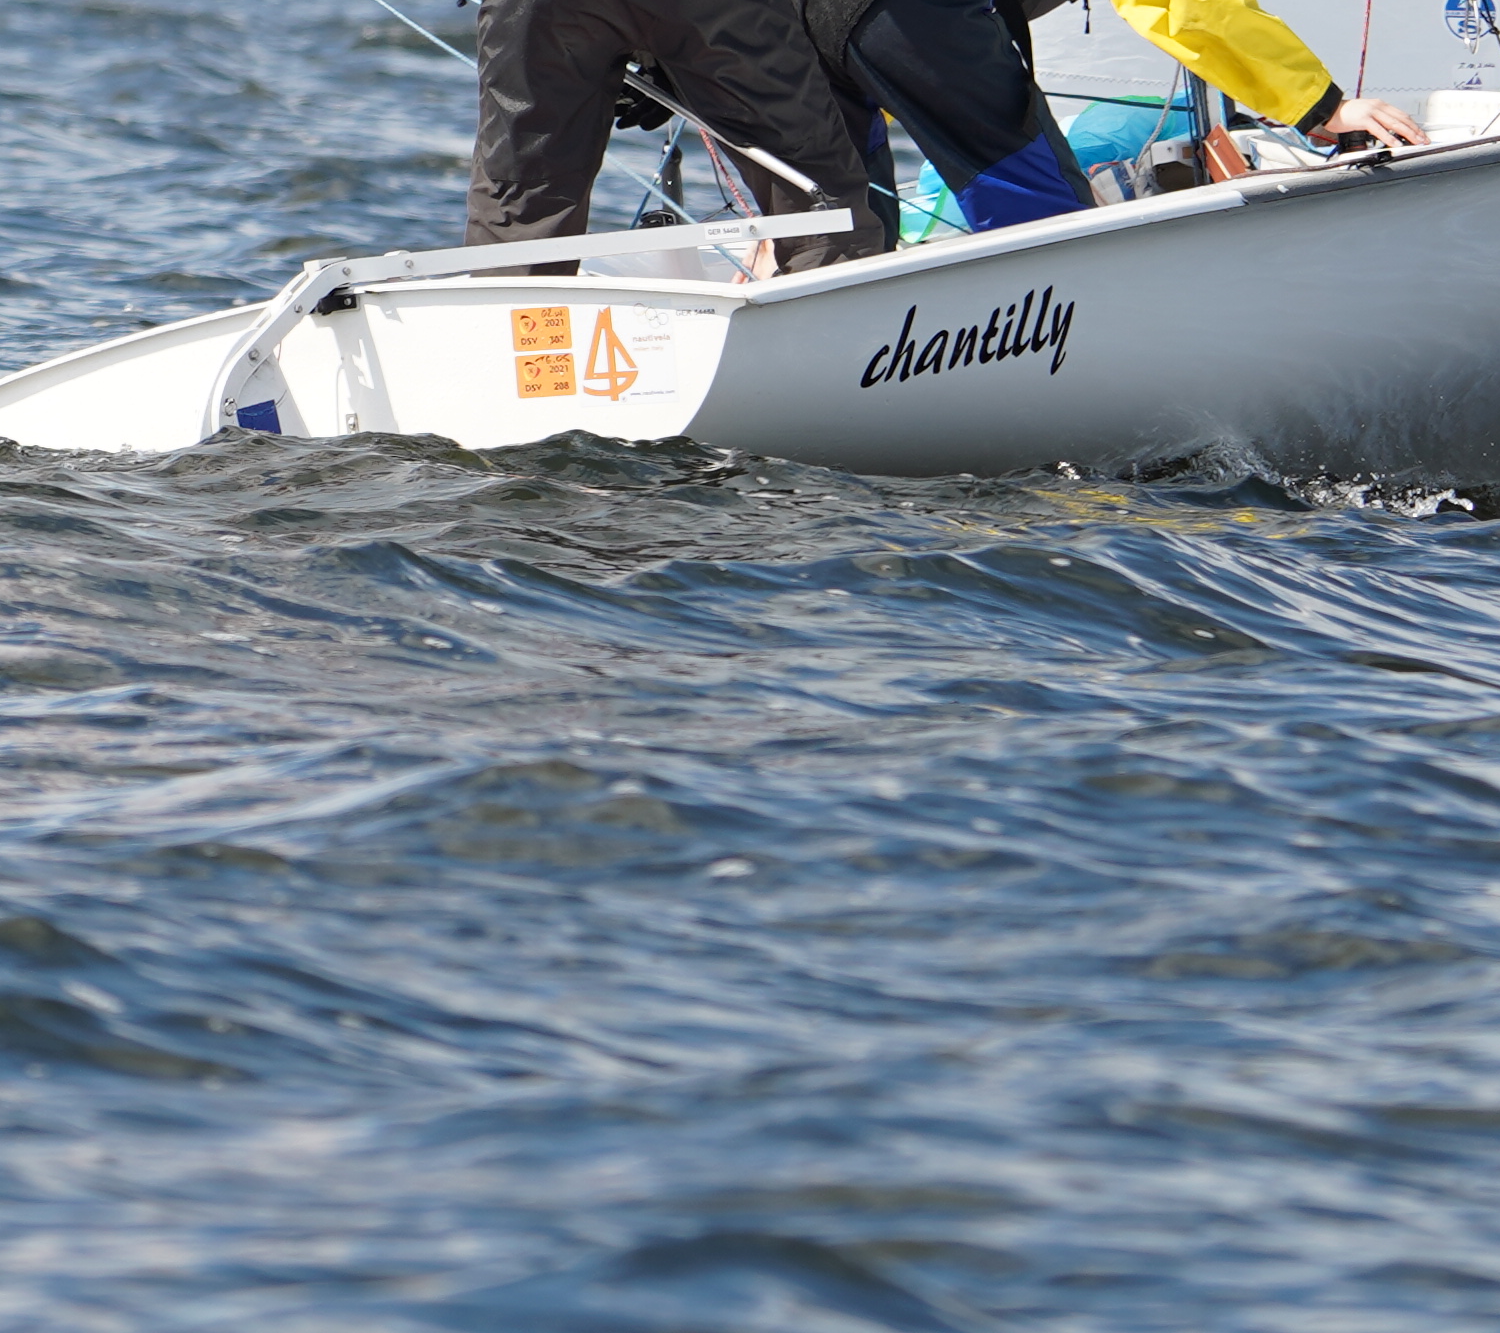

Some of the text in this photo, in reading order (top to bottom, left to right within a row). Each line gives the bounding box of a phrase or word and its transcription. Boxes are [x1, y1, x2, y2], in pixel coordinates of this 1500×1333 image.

[545, 319, 565, 328] 2021
[521, 337, 537, 345] DSV
[860, 285, 1075, 388] chantilly
[549, 365, 569, 374] 2021
[525, 384, 542, 393] DSV
